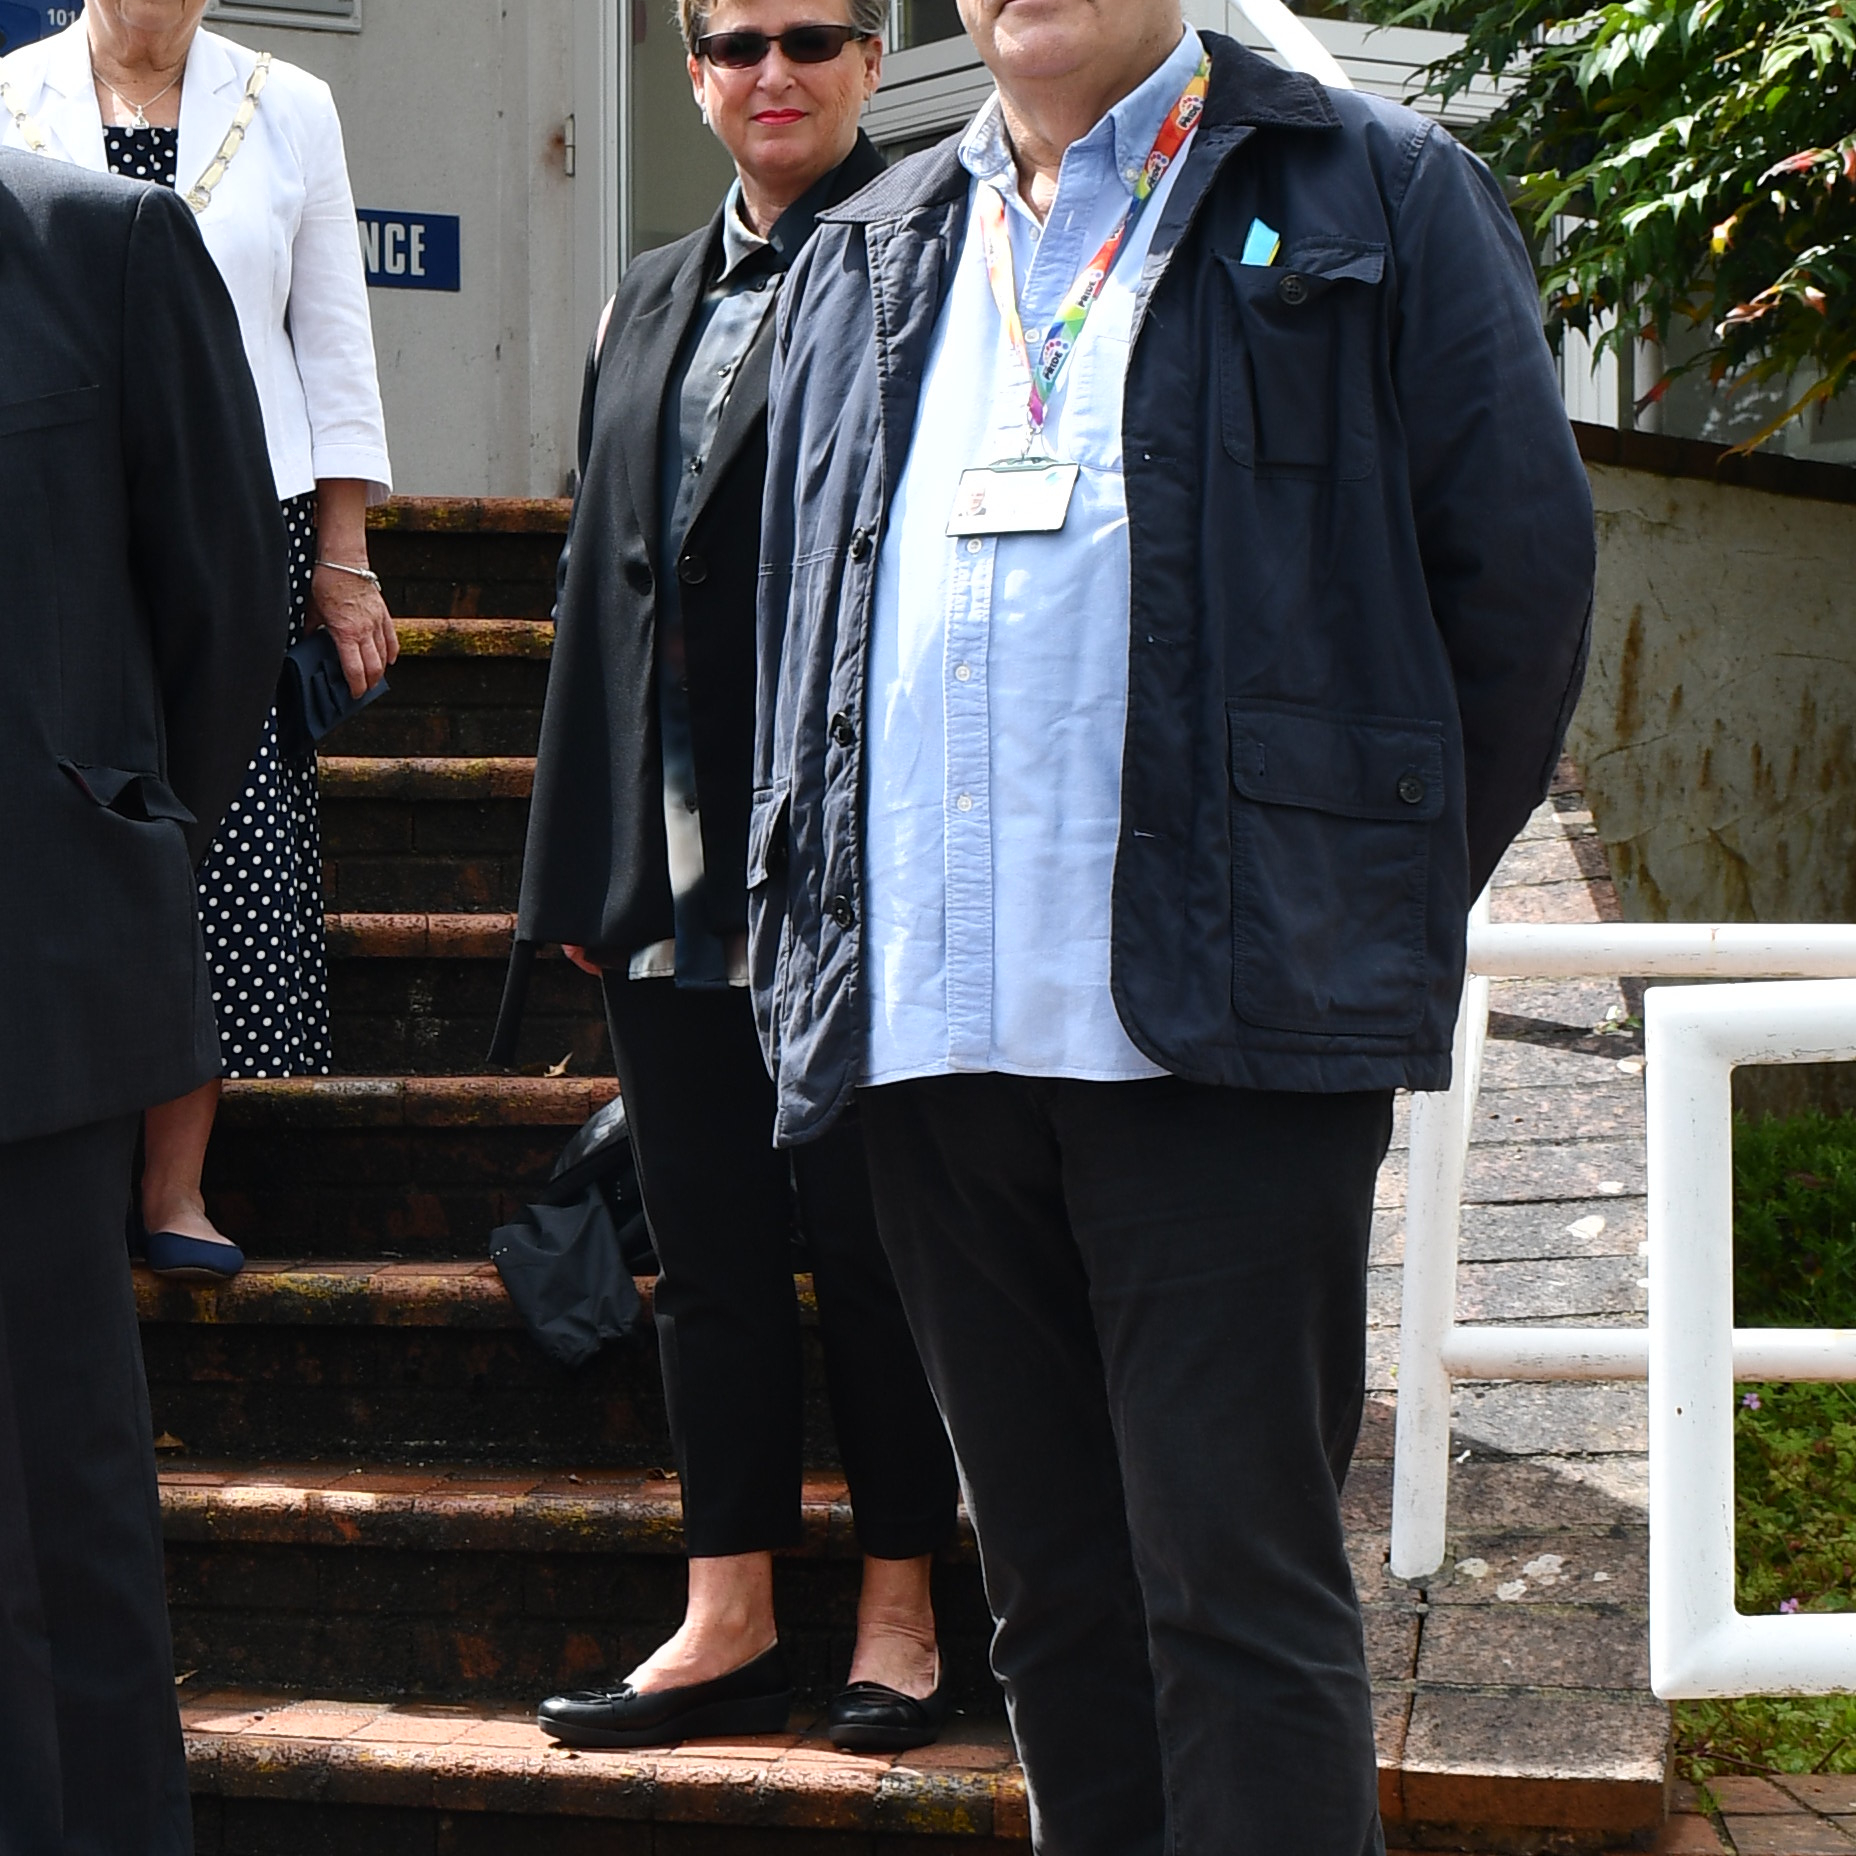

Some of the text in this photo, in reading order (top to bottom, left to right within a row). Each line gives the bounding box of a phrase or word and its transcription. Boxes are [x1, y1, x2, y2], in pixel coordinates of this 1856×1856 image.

[47, 8, 76, 26] 101
[357, 220, 425, 276] NCE
[1077, 280, 1097, 308] PRIDE
[1043, 350, 1064, 381] PRIDE
